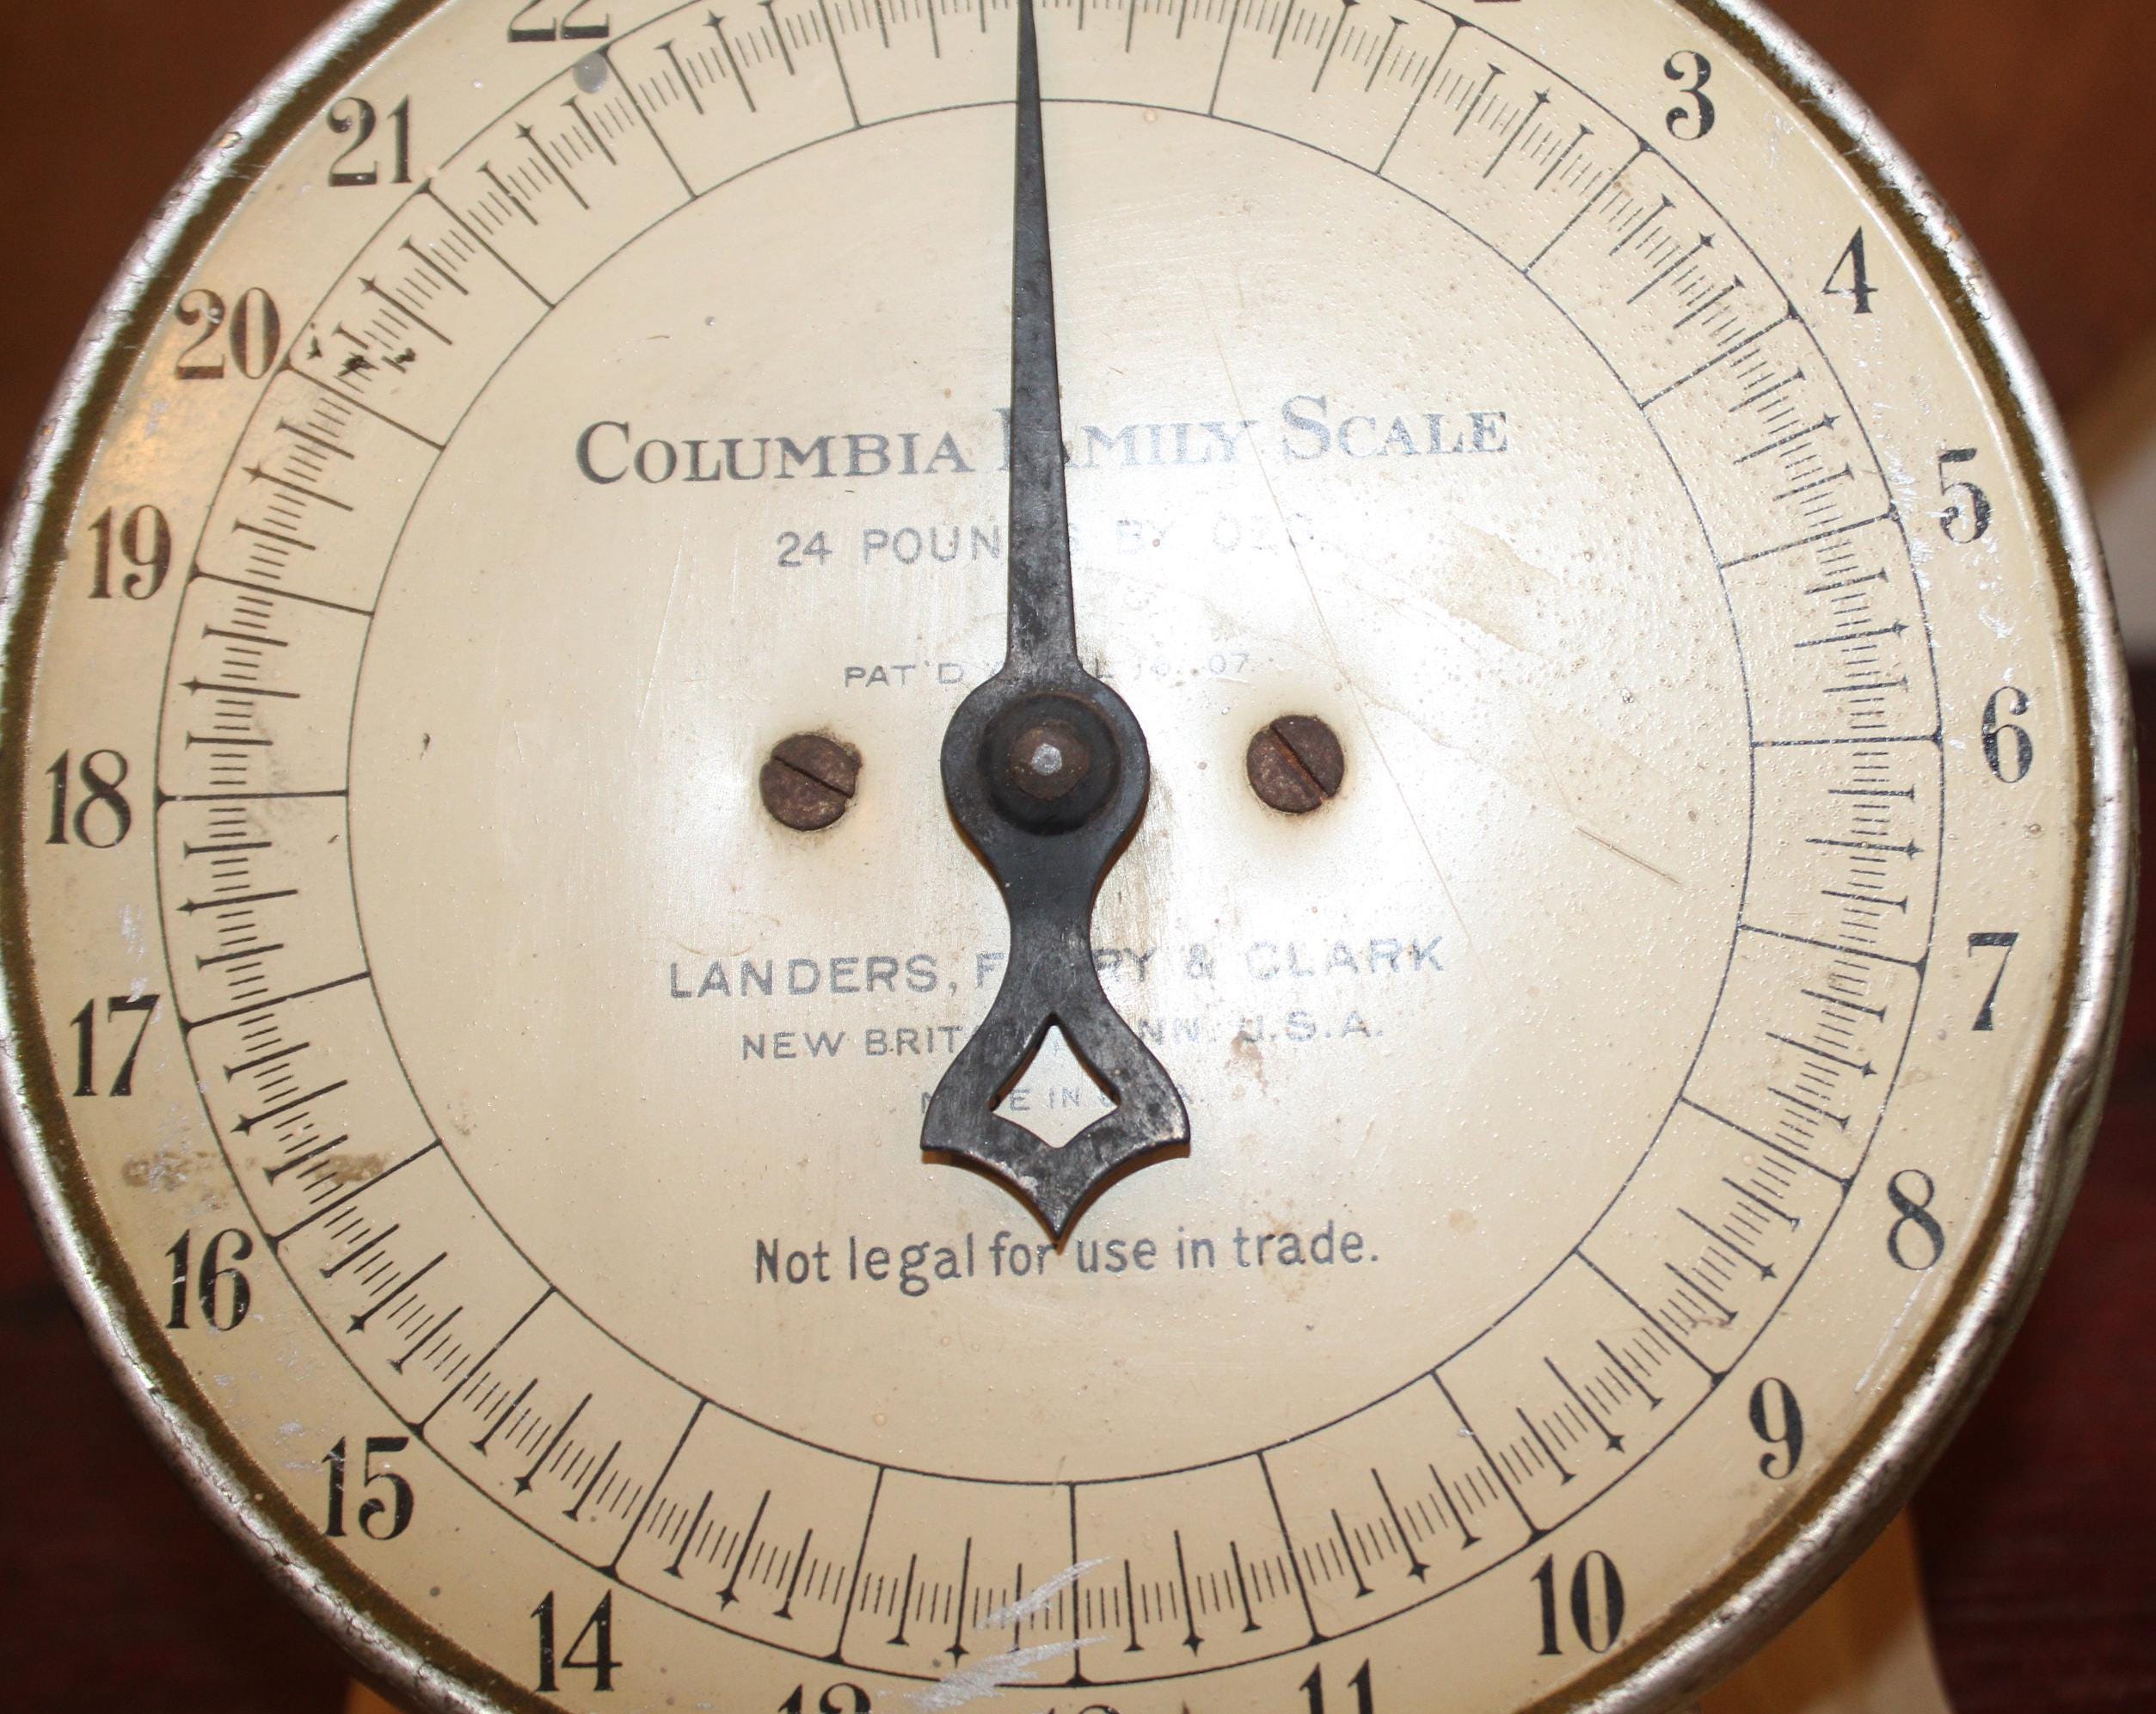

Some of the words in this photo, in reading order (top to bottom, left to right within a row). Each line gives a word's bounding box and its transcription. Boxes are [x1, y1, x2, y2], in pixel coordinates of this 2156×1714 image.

[326, 94, 412, 187] 21
[1663, 49, 1715, 141] 3
[1822, 225, 1878, 314] 4
[174, 287, 281, 380] 20
[994, 407, 1258, 471] MILY
[1937, 446, 1992, 544] 5
[88, 504, 171, 600] 19
[777, 530, 832, 568] 24
[862, 525, 1080, 566] POUN
[1981, 686, 2033, 783] 6
[46, 748, 132, 848] 18
[670, 953, 957, 998] LANDERS,
[975, 948, 1157, 989] FRY
[1247, 936, 1444, 980] CLARK
[1968, 931, 2018, 1031] 7
[70, 993, 160, 1097] 17
[741, 1032, 845, 1060] NEW
[1048, 1086, 1081, 1109] IN
[756, 1238, 832, 1285] Not
[848, 1236, 975, 1297] legal
[988, 1232, 1060, 1276] for
[1075, 1235, 1158, 1273] use
[1178, 1226, 1217, 1269] in
[1232, 1220, 1379, 1268] trade.
[1887, 1169, 1945, 1271] 8
[163, 1227, 255, 1332] 16
[1748, 1377, 1804, 1480] 9
[320, 1435, 416, 1541] 15
[529, 1589, 623, 1692] 14
[1530, 1550, 1625, 1656] 10
